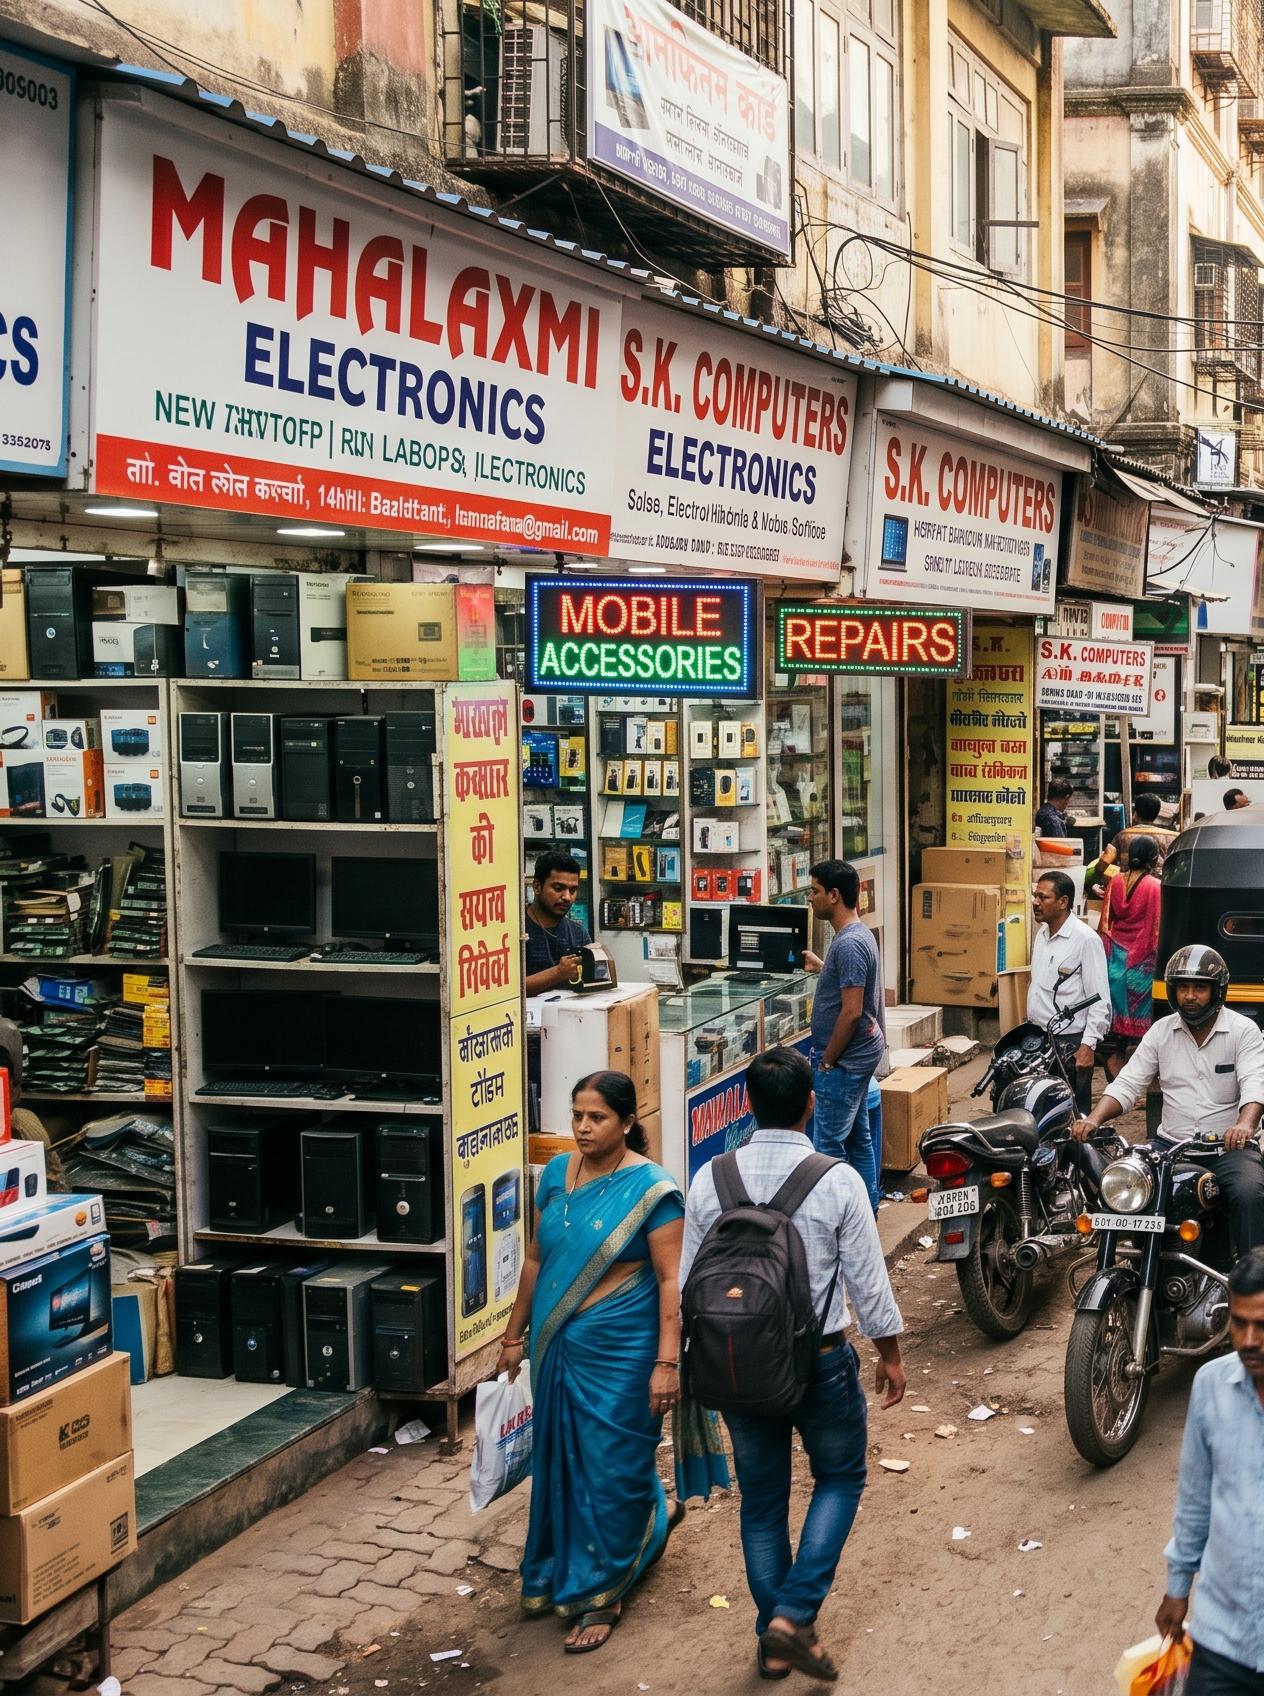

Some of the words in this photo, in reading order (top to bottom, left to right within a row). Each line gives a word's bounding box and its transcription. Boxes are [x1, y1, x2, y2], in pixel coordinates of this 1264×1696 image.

[151, 154, 600, 389] MAHALAXMI
[0, 311, 39, 386] S
[244, 321, 546, 445] ELECTRONICS
[155, 390, 216, 430] NEW
[620, 328, 681, 414] S.K.
[693, 351, 849, 456] COMPUTERS
[646, 428, 817, 505] ELECTRONICS
[884, 436, 930, 507] S.K.
[938, 451, 1056, 534] COMPUTERS
[560, 595, 722, 637] MOBILE
[786, 618, 956, 663] REPAIRS
[1041, 640, 1077, 661] S.K.
[1081, 646, 1146, 666] COMPUTERS
[539, 641, 742, 680] ACCESSORIES
